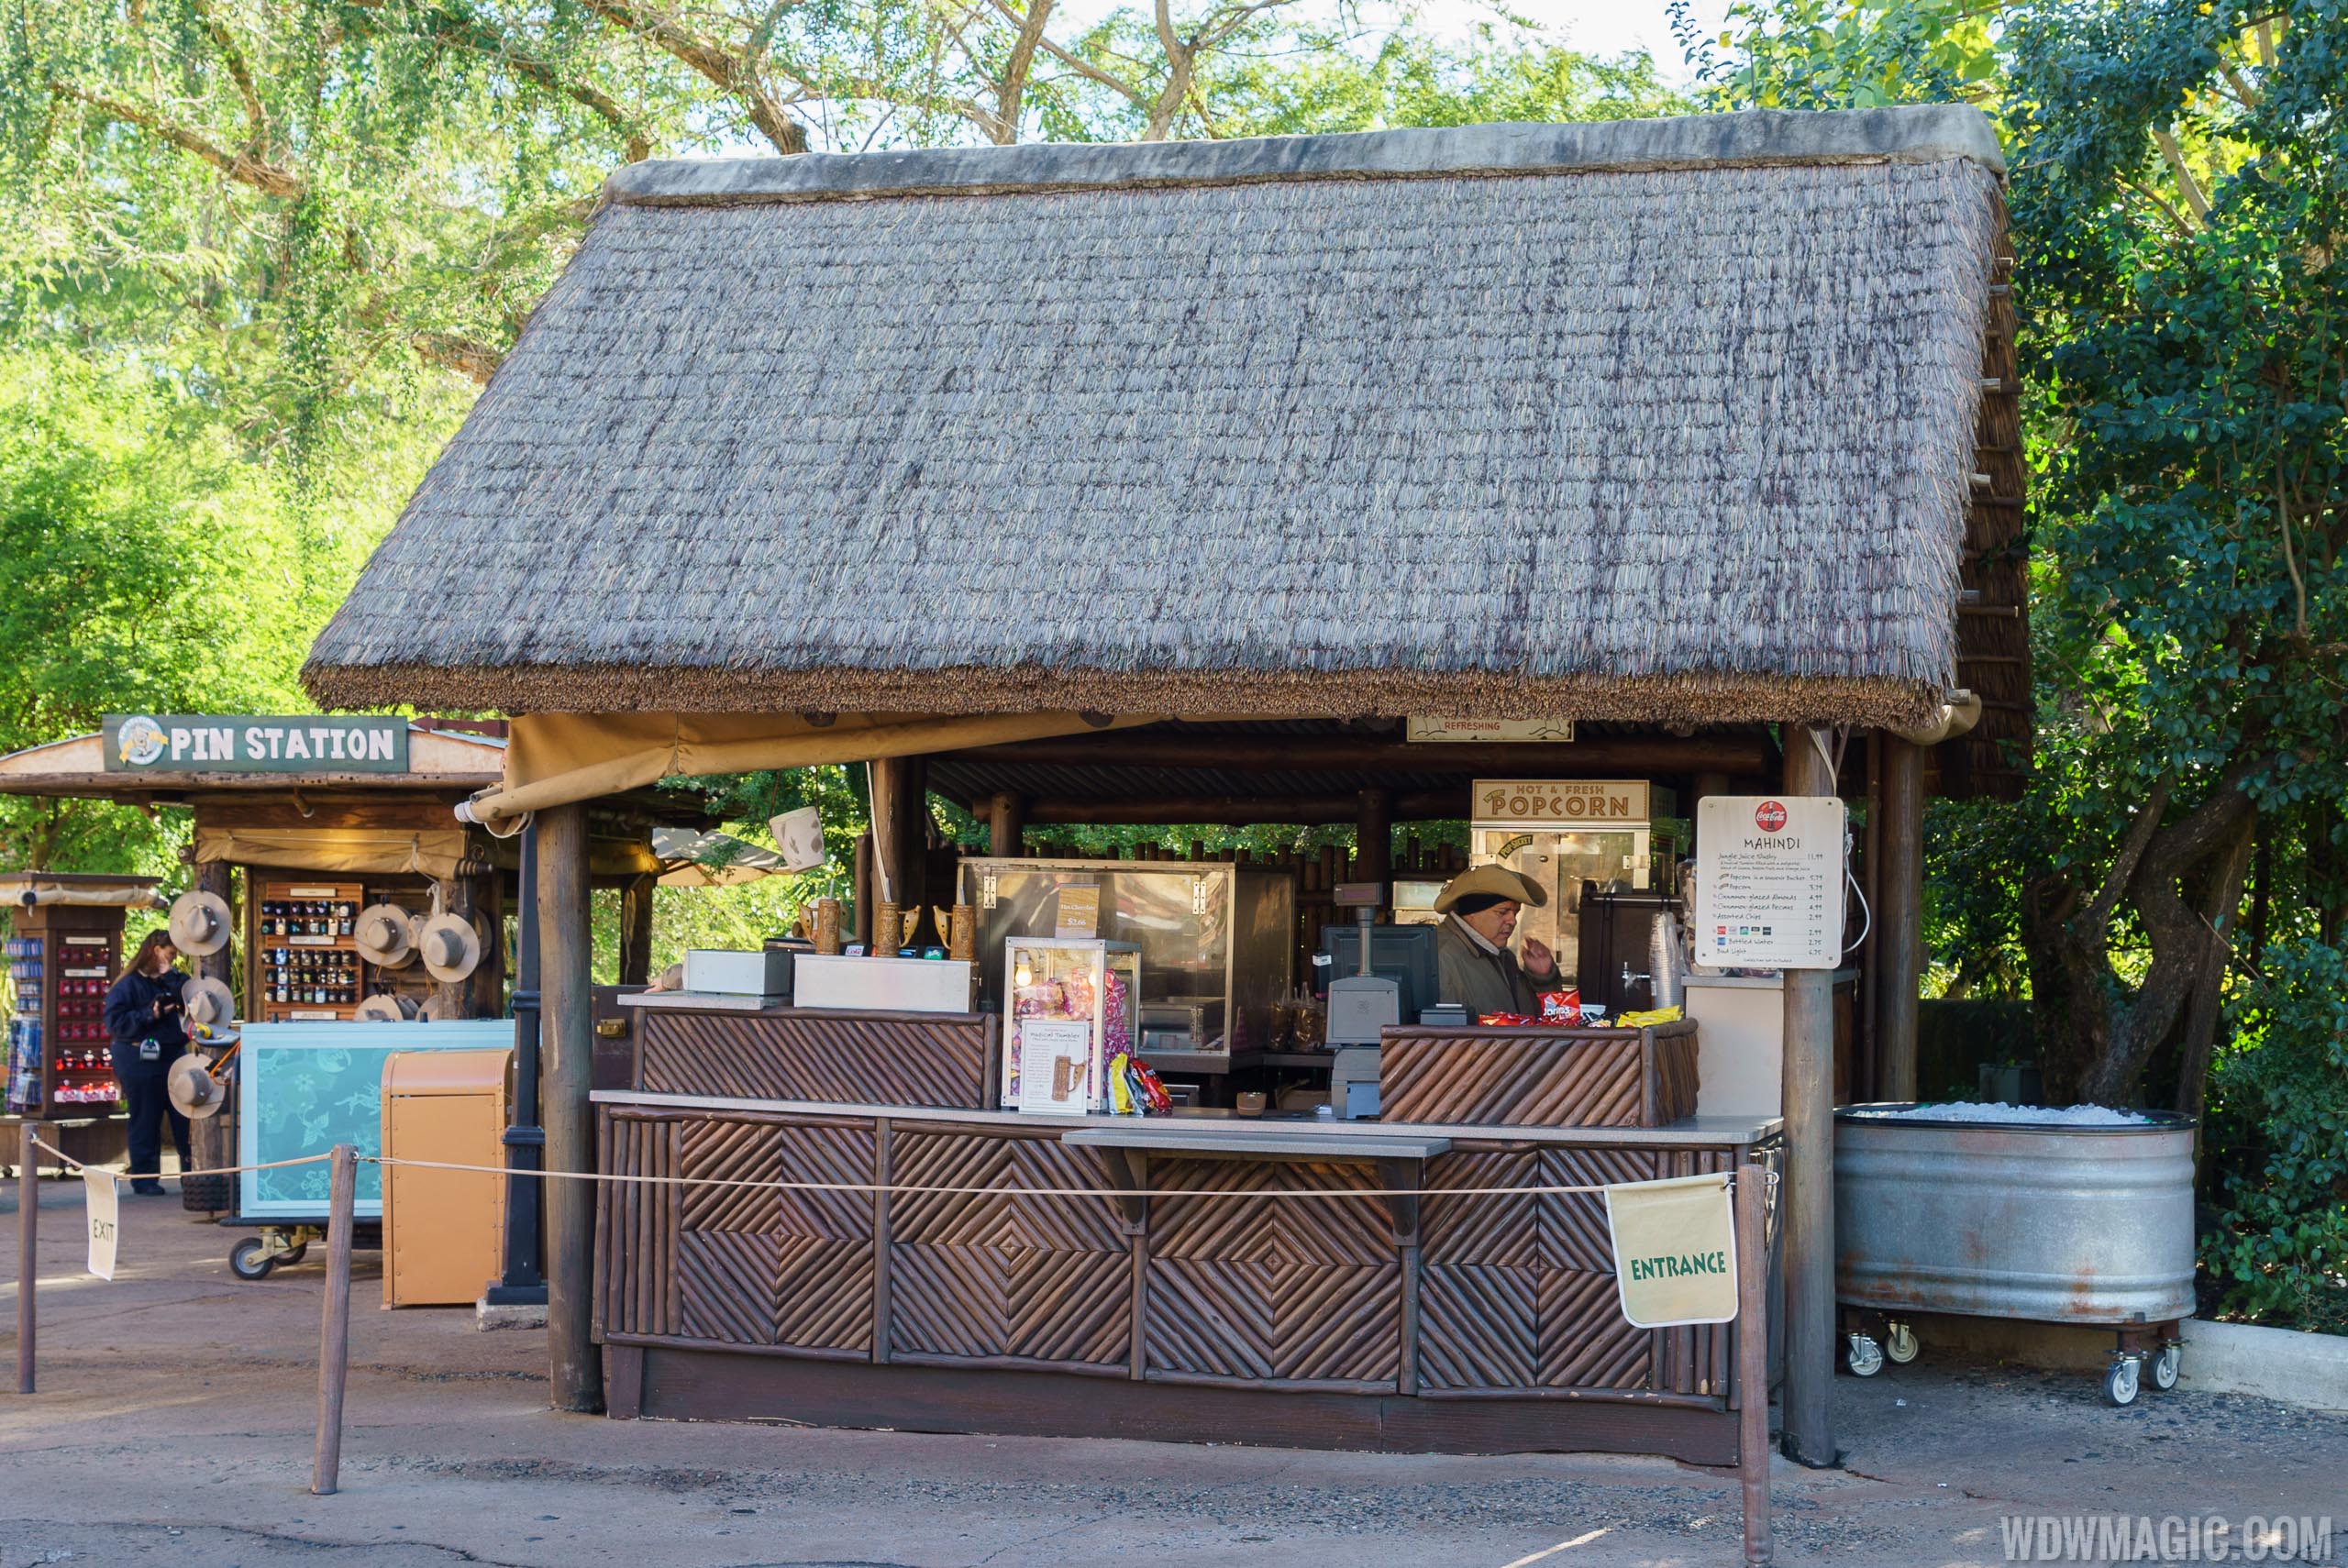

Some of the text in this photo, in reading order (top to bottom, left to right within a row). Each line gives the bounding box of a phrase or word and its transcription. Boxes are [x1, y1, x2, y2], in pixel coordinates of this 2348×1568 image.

[1445, 722, 1501, 731] REFRESHING
[171, 727, 394, 760] PIN STATION
[1516, 785, 1605, 795] HOT & FRESH
[1491, 796, 1629, 816] POPCORN
[1744, 837, 1800, 850] MAHINDI
[93, 1218, 115, 1242] EXIT
[1631, 1251, 1726, 1281] ENTRANCE
